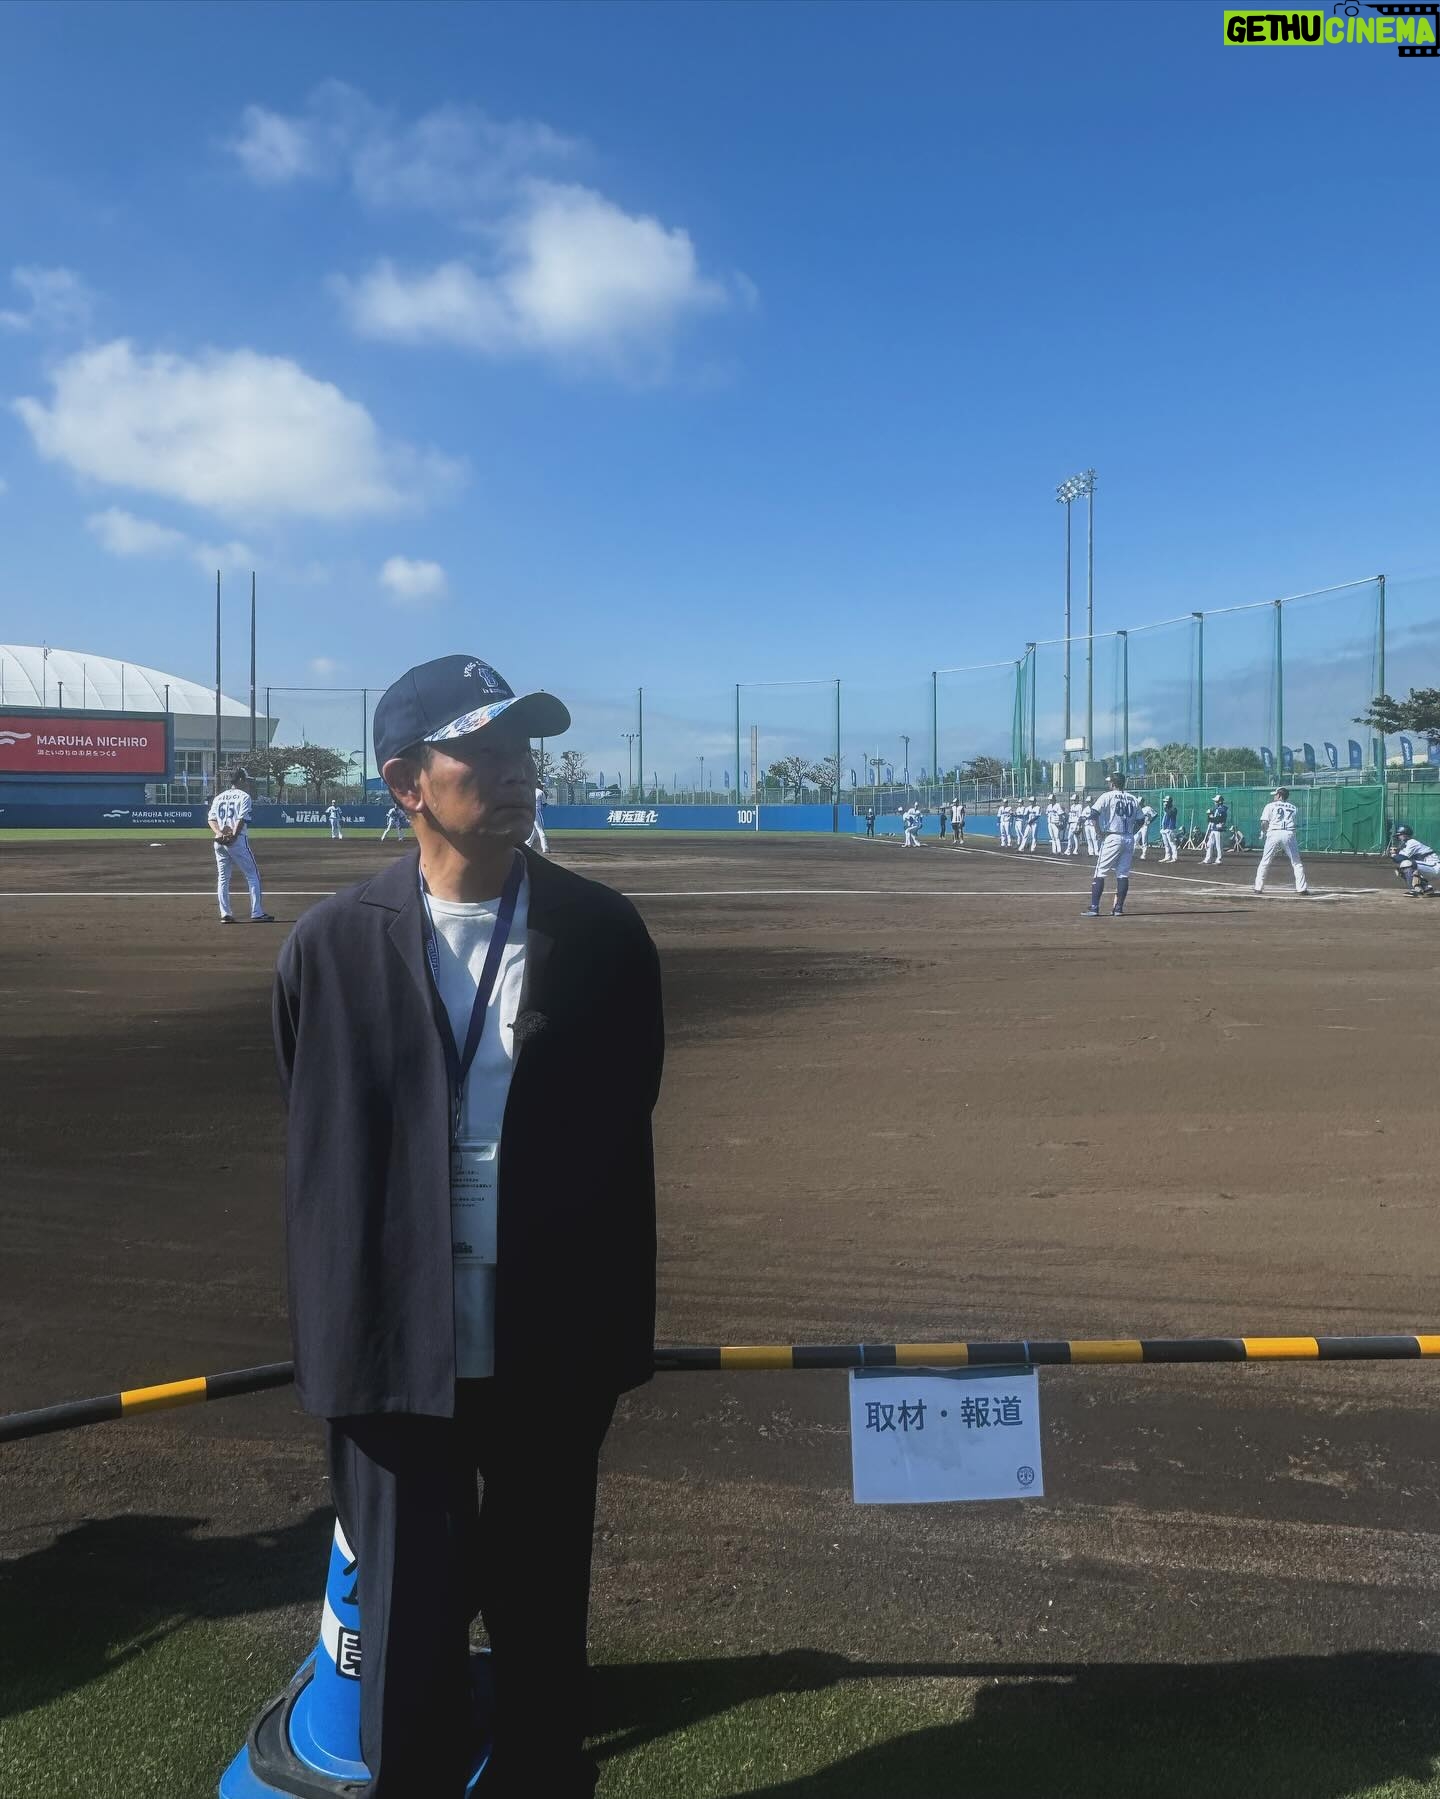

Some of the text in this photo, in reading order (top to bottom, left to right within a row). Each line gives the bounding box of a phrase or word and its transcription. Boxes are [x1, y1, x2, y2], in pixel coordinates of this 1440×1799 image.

[36, 735, 148, 748] MARUHA NICHIRO
[295, 814, 327, 823] UEMA
[1277, 807, 1295, 821] 97
[864, 1395, 1023, 1432] 取材・報道
